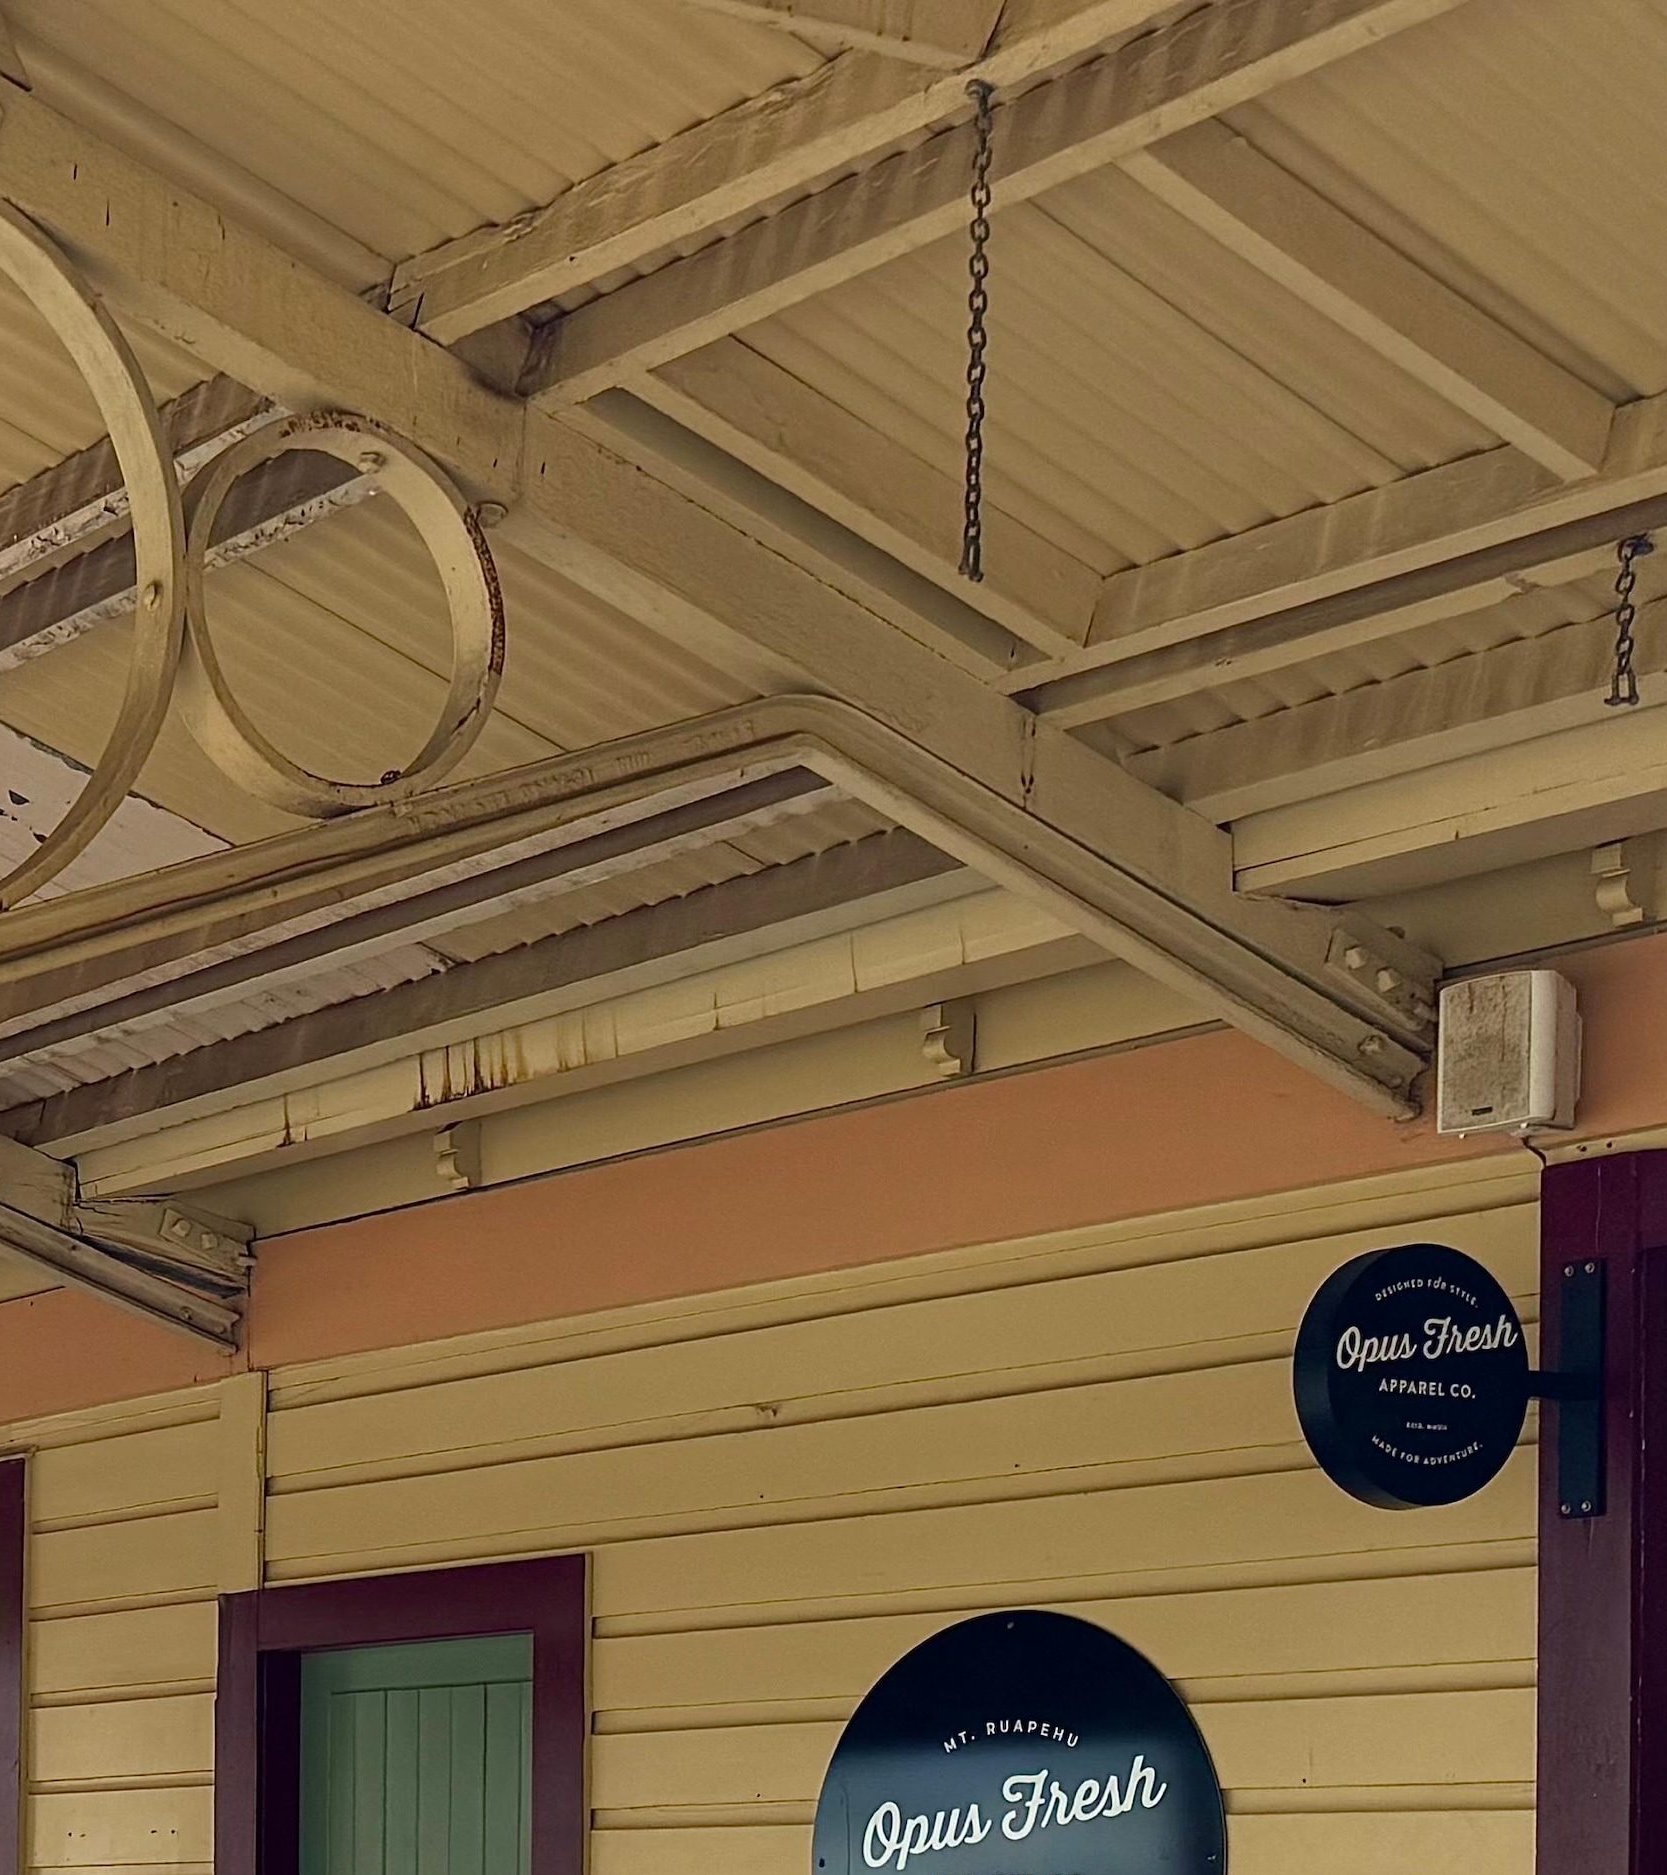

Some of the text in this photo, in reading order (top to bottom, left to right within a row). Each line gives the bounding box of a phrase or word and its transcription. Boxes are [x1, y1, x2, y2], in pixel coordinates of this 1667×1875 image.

[1375, 1279, 1424, 1301] DESIGNED
[1336, 1314, 1518, 1372] Opus Fresh
[1379, 1378, 1476, 1399] APPAREL CO.
[1372, 1435, 1483, 1465] MADE FOR ADVENTURE.
[943, 1719, 1079, 1753] MT. RUAPEHU
[862, 1755, 1167, 1870] Opus Fresh
